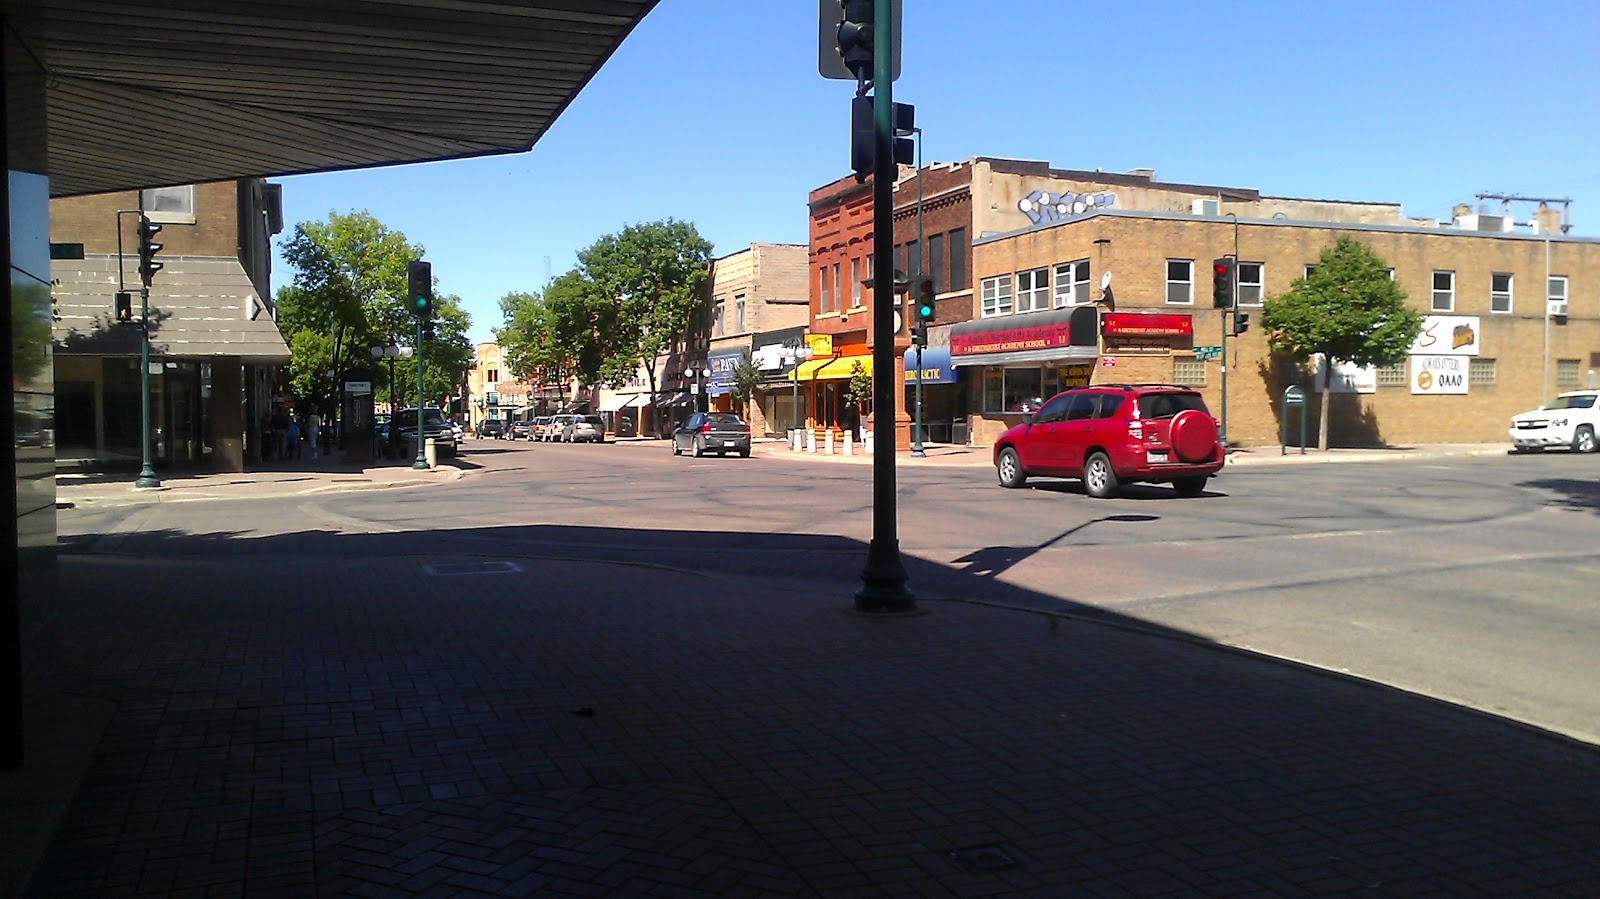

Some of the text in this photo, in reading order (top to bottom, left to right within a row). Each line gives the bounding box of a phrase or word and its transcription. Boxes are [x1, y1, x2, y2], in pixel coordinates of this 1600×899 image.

[1001, 341, 1024, 350] ACADEMY
[1025, 339, 1046, 348] SCHOOL
[1438, 374, 1462, 387] OAAO
